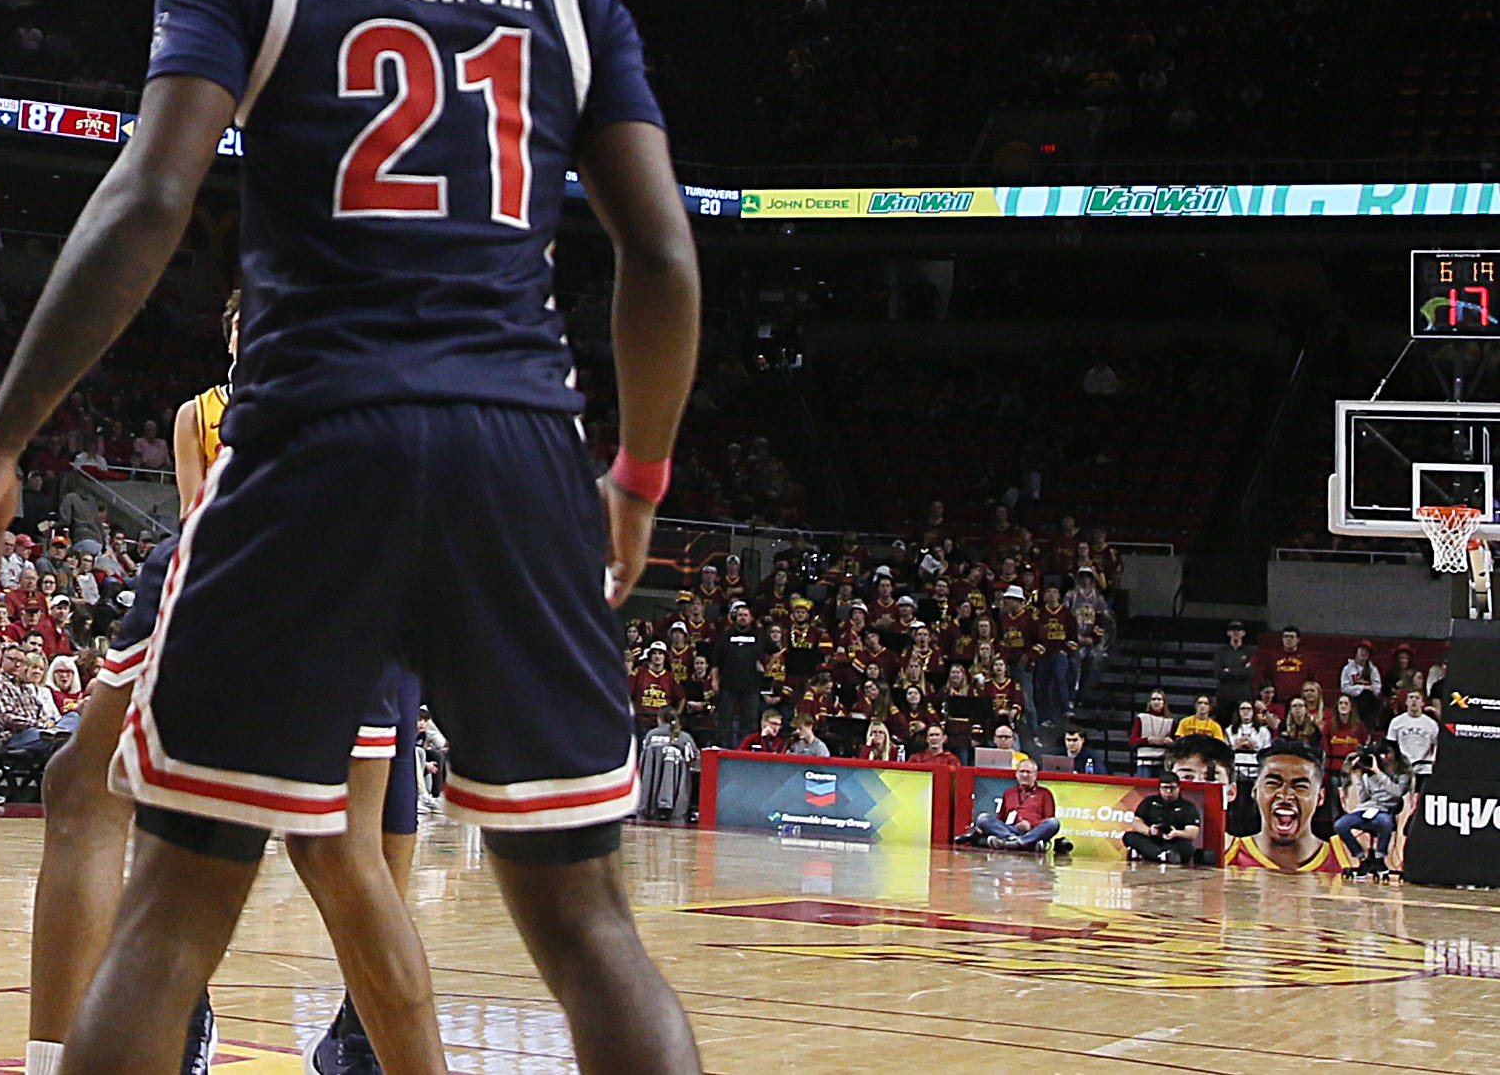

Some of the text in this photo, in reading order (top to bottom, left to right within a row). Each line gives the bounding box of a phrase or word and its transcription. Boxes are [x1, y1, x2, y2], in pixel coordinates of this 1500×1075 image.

[27, 105, 112, 135] 87 STATE
[332, 17, 534, 232] 21
[684, 185, 740, 201] TURNOVERS
[700, 199, 722, 216] 20
[766, 197, 850, 211] JOHN DEERE
[1440, 261, 1494, 282] 6 19
[1447, 286, 1490, 326] 17
[781, 812, 871, 830] Renewable Energy Group
